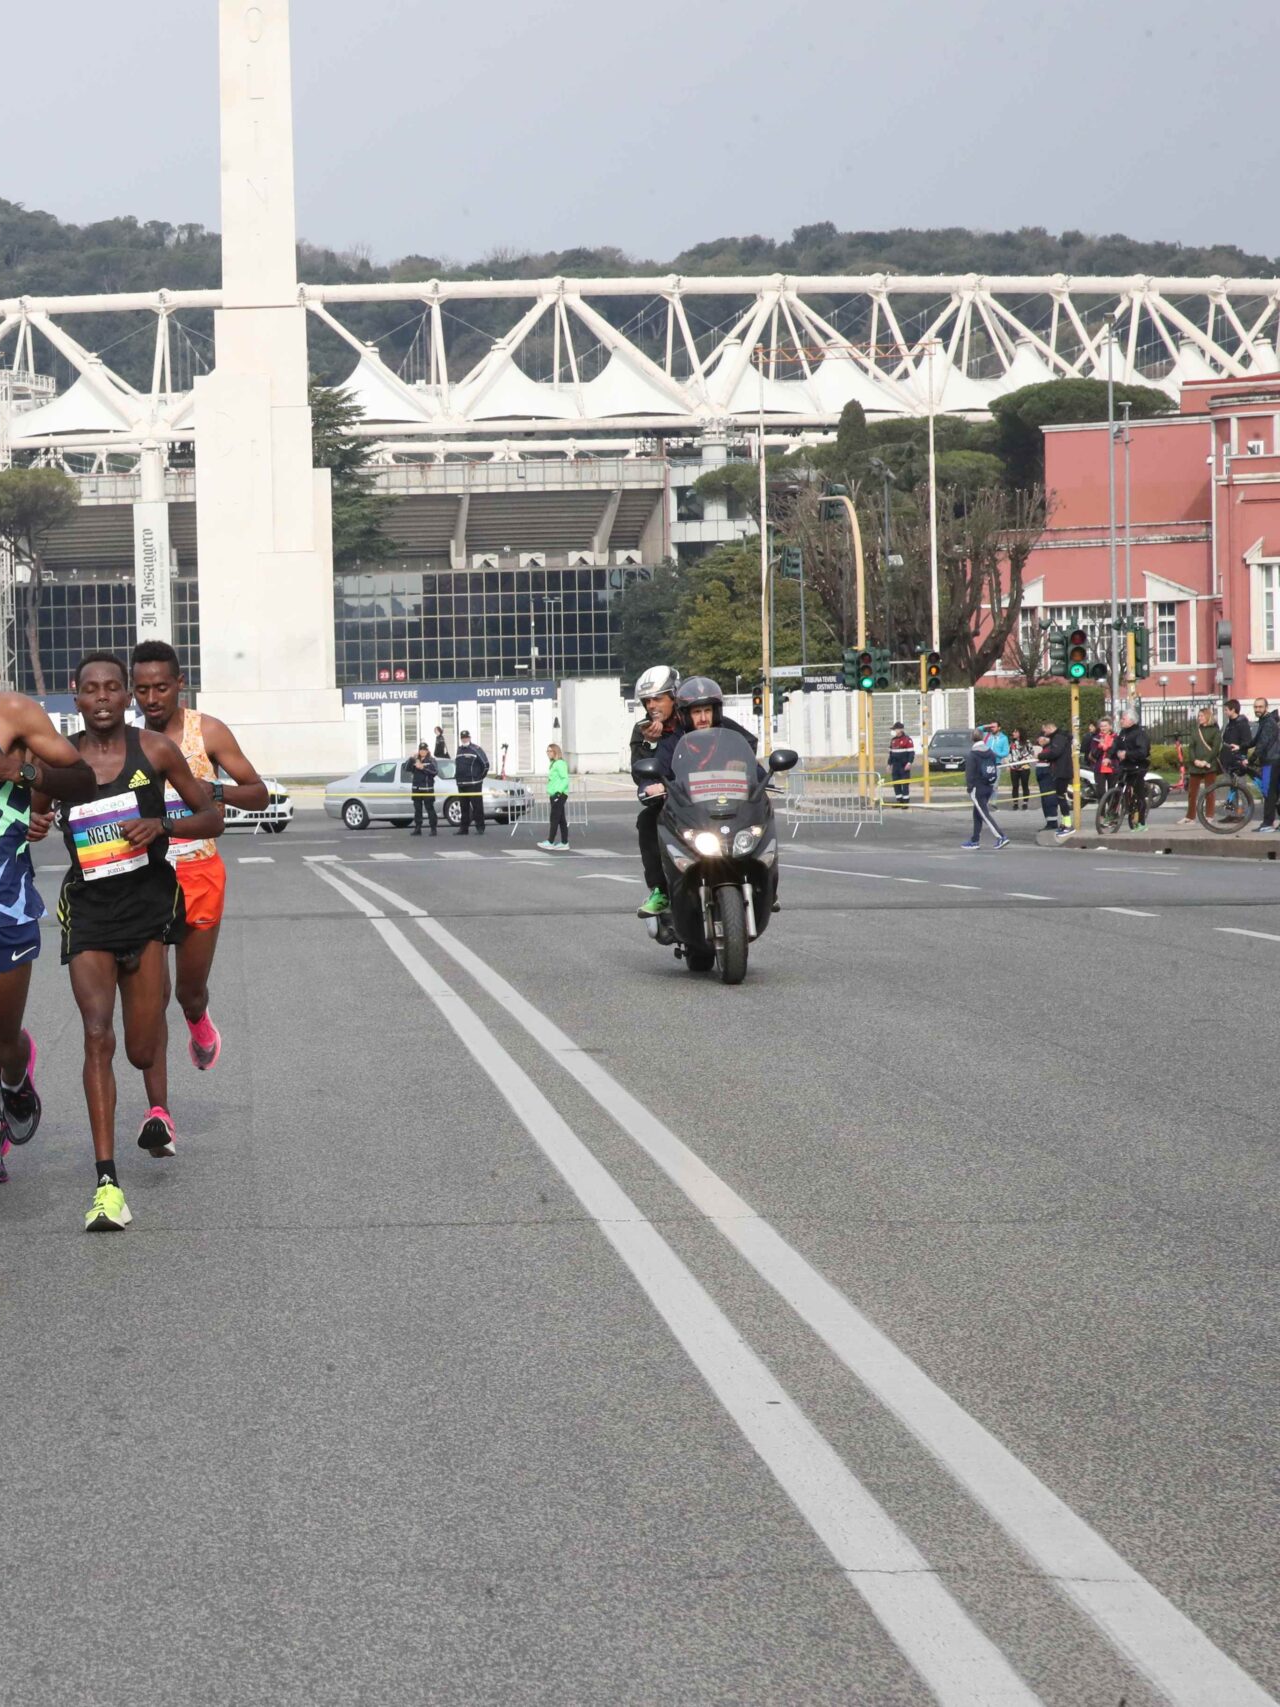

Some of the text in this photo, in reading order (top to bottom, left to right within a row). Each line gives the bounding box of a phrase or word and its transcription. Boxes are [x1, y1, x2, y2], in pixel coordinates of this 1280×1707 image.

[140, 528, 157, 609] Messaggero
[380, 671, 390, 679] 23
[395, 671, 405, 679] 24
[353, 690, 418, 701] TRIBUNA TEVERE
[477, 687, 545, 697] DISTINTI SUD EST
[128, 779, 151, 789] adidas
